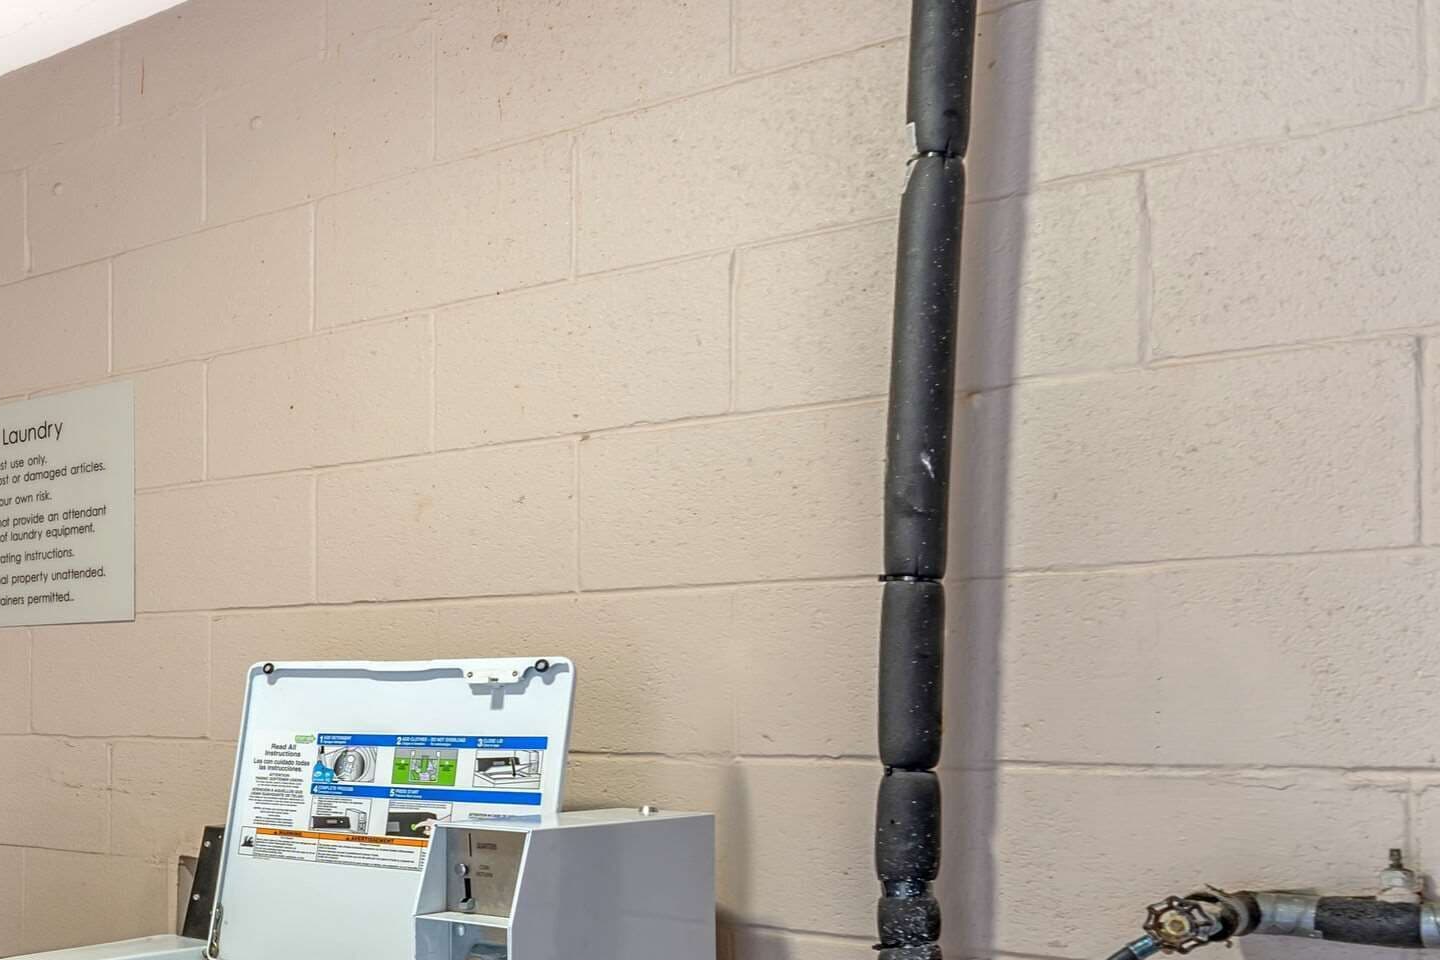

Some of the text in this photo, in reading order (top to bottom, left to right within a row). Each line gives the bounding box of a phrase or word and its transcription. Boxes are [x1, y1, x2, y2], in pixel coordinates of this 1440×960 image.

[2, 421, 63, 445] Laundry
[10, 459, 24, 468] use
[28, 455, 47, 466] only.
[12, 474, 20, 484] or
[24, 467, 67, 482] damaged
[71, 461, 106, 474] articles.
[15, 494, 33, 504] own
[36, 491, 52, 502] risk.
[13, 513, 44, 528] provide
[48, 513, 59, 522] an
[62, 505, 106, 521] attendant
[0, 532, 8, 543] of
[11, 530, 42, 543] laundry
[46, 523, 95, 538] equipment.
[24, 548, 75, 561] instructions.
[12, 571, 48, 586] property
[51, 567, 106, 580] unattended.
[28, 592, 74, 606] permitted.
